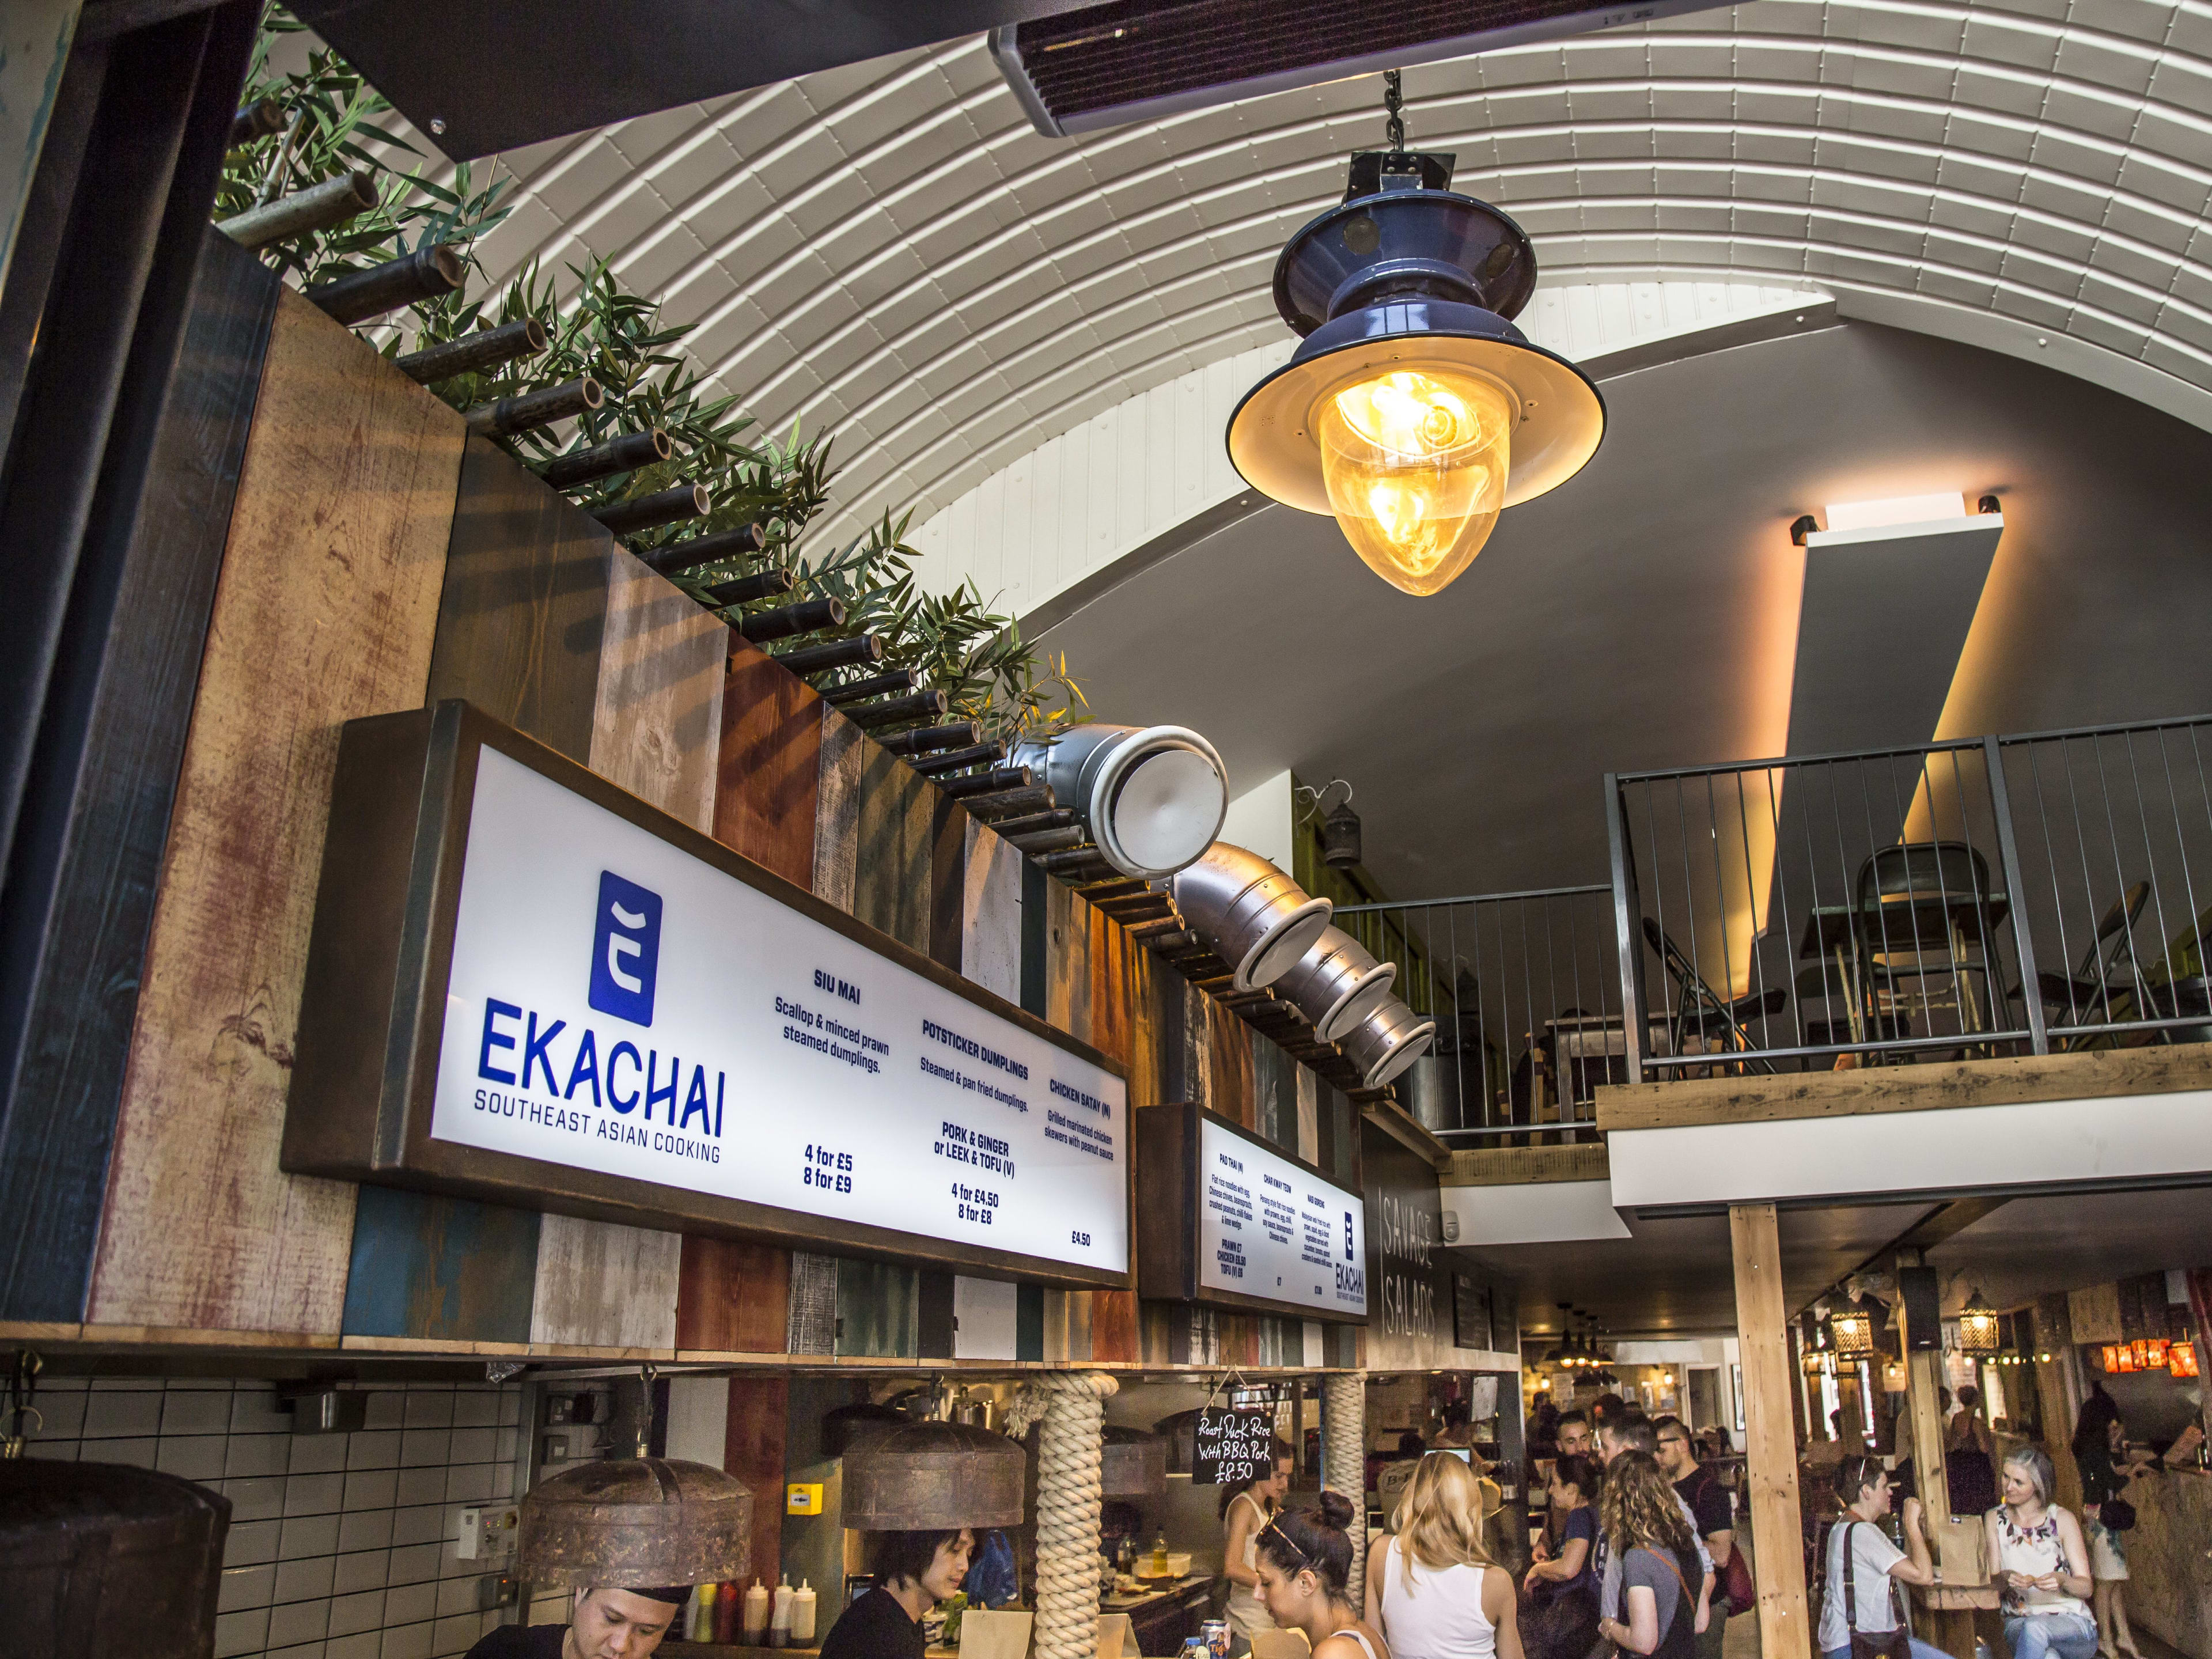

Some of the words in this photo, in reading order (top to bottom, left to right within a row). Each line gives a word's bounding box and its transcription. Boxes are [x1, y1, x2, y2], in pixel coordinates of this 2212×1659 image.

[815, 969, 835, 993] SIU
[838, 980, 861, 1005] MAI
[775, 997, 813, 1027] Scallop
[816, 1014, 823, 1029] &
[825, 1020, 860, 1044] minced
[862, 1035, 889, 1055] prawn
[783, 1026, 828, 1054] steamed
[831, 1041, 880, 1073] dumplings.
[923, 1019, 979, 1058] POTSTICKER
[981, 1046, 1028, 1080] DUMPLINGS
[478, 997, 725, 1138] EKACHAI
[921, 1056, 955, 1082] Steamed
[956, 1071, 961, 1085] &
[963, 1076, 976, 1090] pan
[978, 1080, 993, 1098] fried
[994, 1088, 1028, 1112] dumplings.
[1050, 1078, 1080, 1104] CHICKEN
[1081, 1093, 1101, 1113] SATAY
[1101, 1102, 1111, 1120] (N)
[474, 1089, 590, 1134] SOUTHEAST
[597, 1119, 647, 1147] ASIAN
[654, 1132, 719, 1163] COOKING
[942, 1121, 967, 1143] PORK
[969, 1131, 976, 1146] &
[978, 1134, 1009, 1157] GINGER
[1048, 1109, 1066, 1127] Grilled
[1067, 1120, 1093, 1138] marinated
[1094, 1129, 1112, 1145] chicken
[1044, 1125, 1067, 1143] skewers
[1069, 1135, 1080, 1148] with
[1081, 1141, 1099, 1156] peanut
[1099, 1147, 1113, 1161] sauce
[805, 1144, 813, 1162] 4
[817, 1146, 834, 1166] for
[837, 1153, 853, 1171] £5
[934, 1141, 944, 1155] or
[946, 1142, 969, 1163] LEEK
[971, 1150, 978, 1165] &
[979, 1152, 1001, 1172] TOFU
[1003, 1160, 1014, 1180] (V)
[1219, 1153, 1228, 1165] PAD
[1228, 1157, 1237, 1170] THAI
[804, 1166, 812, 1184] 8
[816, 1168, 832, 1189] for
[835, 1175, 851, 1194] £9
[1209, 1185, 1222, 1198] Chinese
[1225, 1181, 1237, 1192] noodles
[1264, 1173, 1273, 1185] CHAR
[1273, 1177, 1283, 1190] KWAY
[1282, 1182, 1291, 1194] TEOW
[952, 1183, 958, 1198] 4
[960, 1184, 972, 1201] for
[974, 1188, 999, 1208] £4.50
[959, 1203, 964, 1219] 8
[967, 1205, 979, 1222] for
[981, 1209, 992, 1225] £8
[1209, 1200, 1222, 1211] crushed
[1244, 1210, 1253, 1221] flakes
[1072, 1230, 1090, 1247] £4.50
[1222, 1238, 1237, 1252] PRAWN
[1384, 1196, 1433, 1269] SAVAGE
[1217, 1249, 1235, 1264] CHICKEN
[1221, 1263, 1232, 1275] TOFU
[1336, 1262, 1364, 1295] EKACHAI
[1386, 1274, 1434, 1339] SALADS
[1198, 1416, 1222, 1439] Roast
[1224, 1414, 1249, 1441] Duck
[1250, 1416, 1271, 1437] Rice
[1198, 1442, 1221, 1460] With
[1222, 1440, 1249, 1460] BBQ
[1251, 1440, 1271, 1461] Pork
[1215, 1461, 1253, 1484] £8.50
